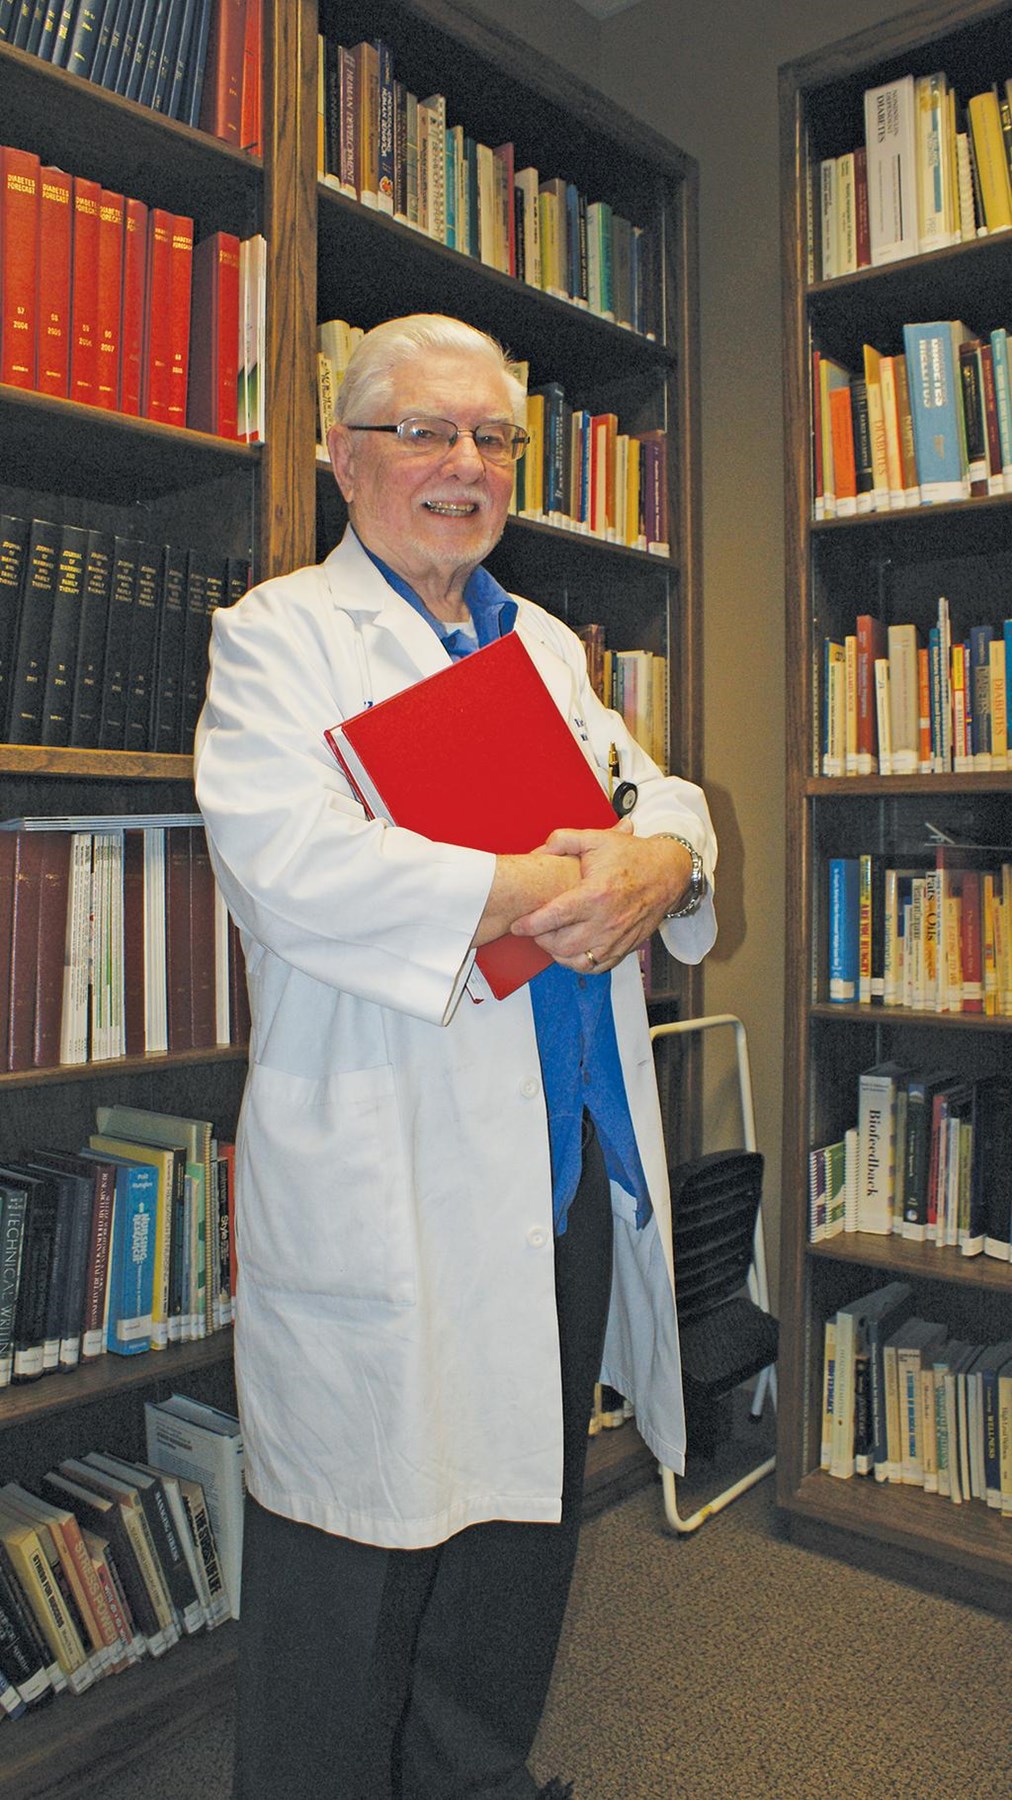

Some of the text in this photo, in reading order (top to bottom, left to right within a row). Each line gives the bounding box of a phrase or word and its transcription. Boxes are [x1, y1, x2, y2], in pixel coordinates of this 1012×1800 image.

[345, 69, 355, 184] HUMAN DEVELOPMENT
[876, 95, 886, 143] DIABETES
[7, 174, 35, 187] DIABETES
[7, 181, 35, 195] FORECAST
[42, 183, 69, 197] DIABETES
[42, 190, 69, 204] FORECAST
[13, 320, 28, 330] 2004
[101, 343, 115, 352] 2007
[931, 338, 943, 407] DIABETES
[873, 419, 887, 477] DIABETES
[62, 550, 82, 560] JOURNAL
[59, 585, 80, 595] THERAPY
[61, 578, 78, 588] FAMILY
[993, 678, 1005, 737] DIABETES
[926, 874, 936, 941] Fats Oils
[866, 1109, 881, 1197] Biofeedback
[219, 1215, 229, 1240] Style
[0, 1212, 21, 1355] TECHNICAL WRITIN
[987, 1415, 995, 1459] WELLNESS
[194, 1507, 208, 1531] THE
[207, 1571, 222, 1596] LIFE
[75, 1541, 118, 1643] STRESS POWER
